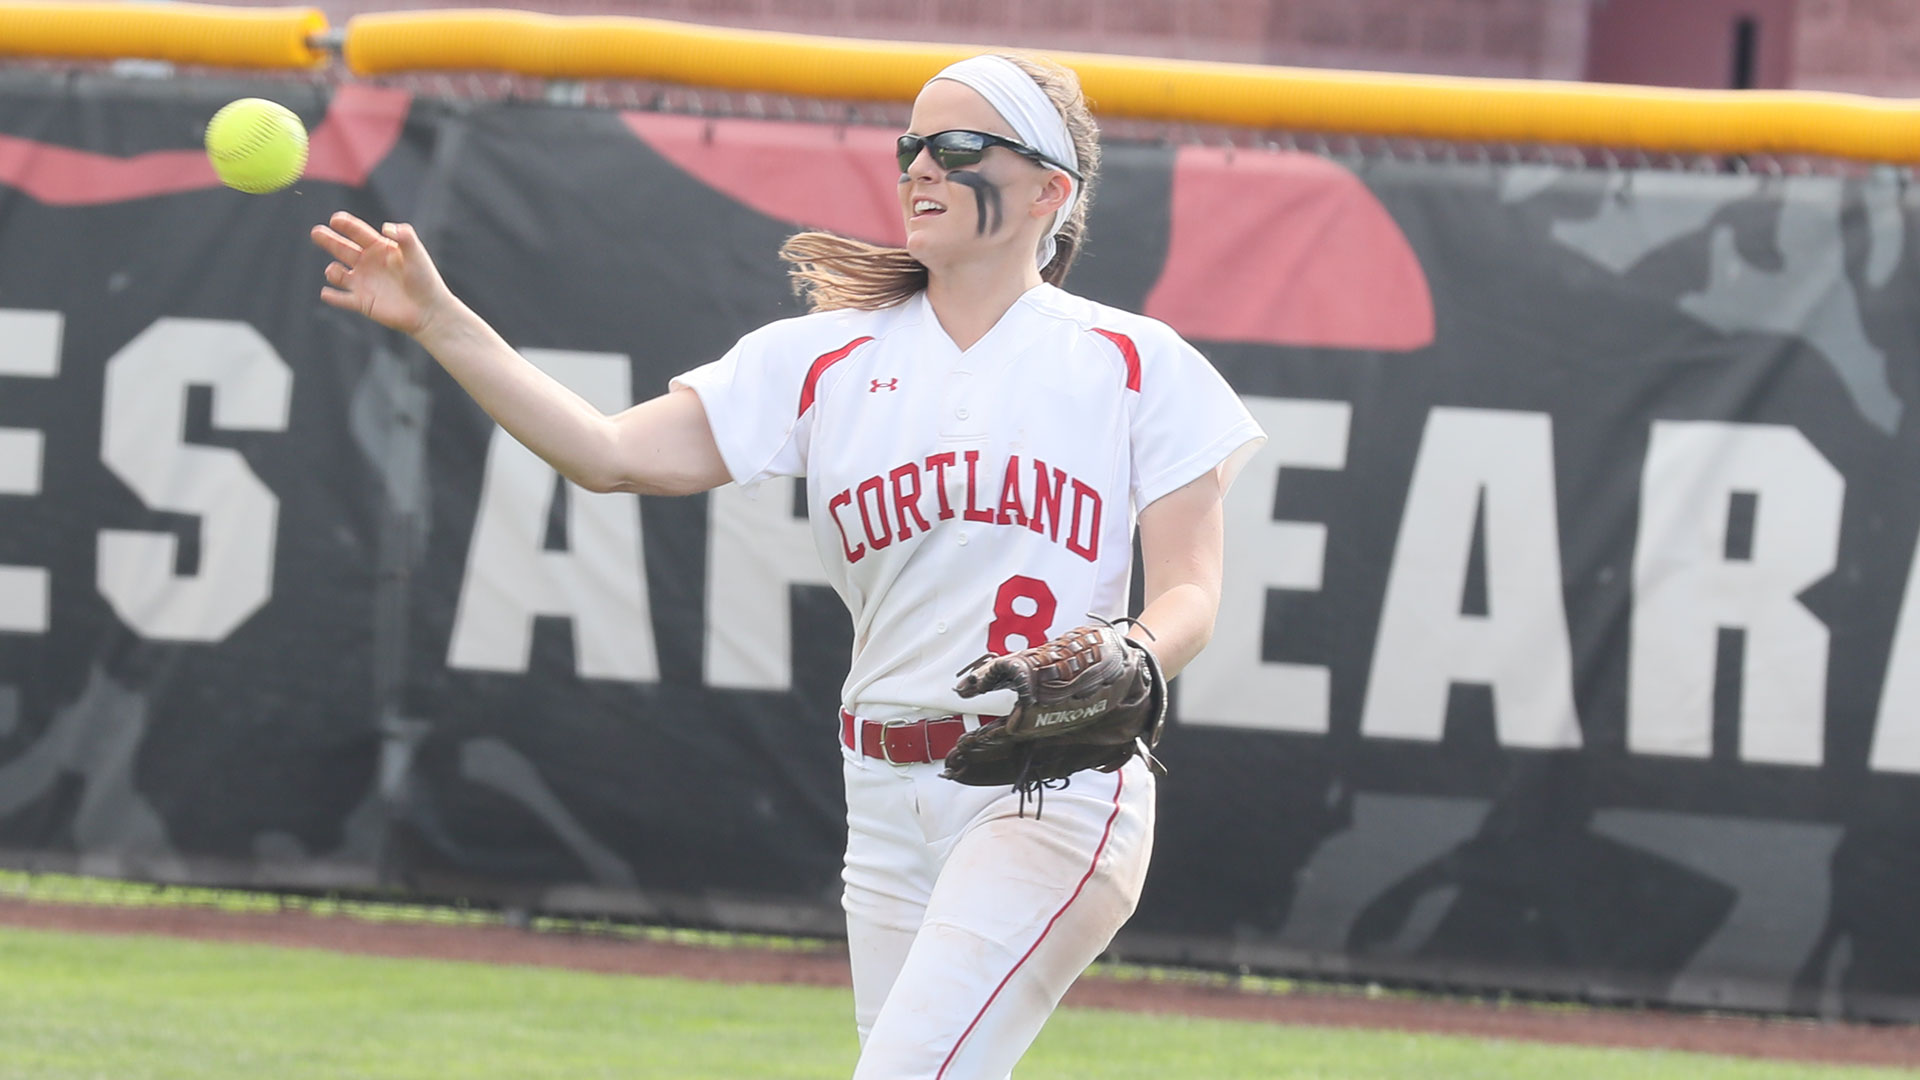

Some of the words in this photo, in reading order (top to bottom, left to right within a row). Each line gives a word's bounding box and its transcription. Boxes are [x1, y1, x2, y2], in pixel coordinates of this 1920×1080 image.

[828, 450, 1103, 564] CORTLAND
[986, 574, 1058, 657] 8
[1034, 699, 1108, 728] NOKONA
